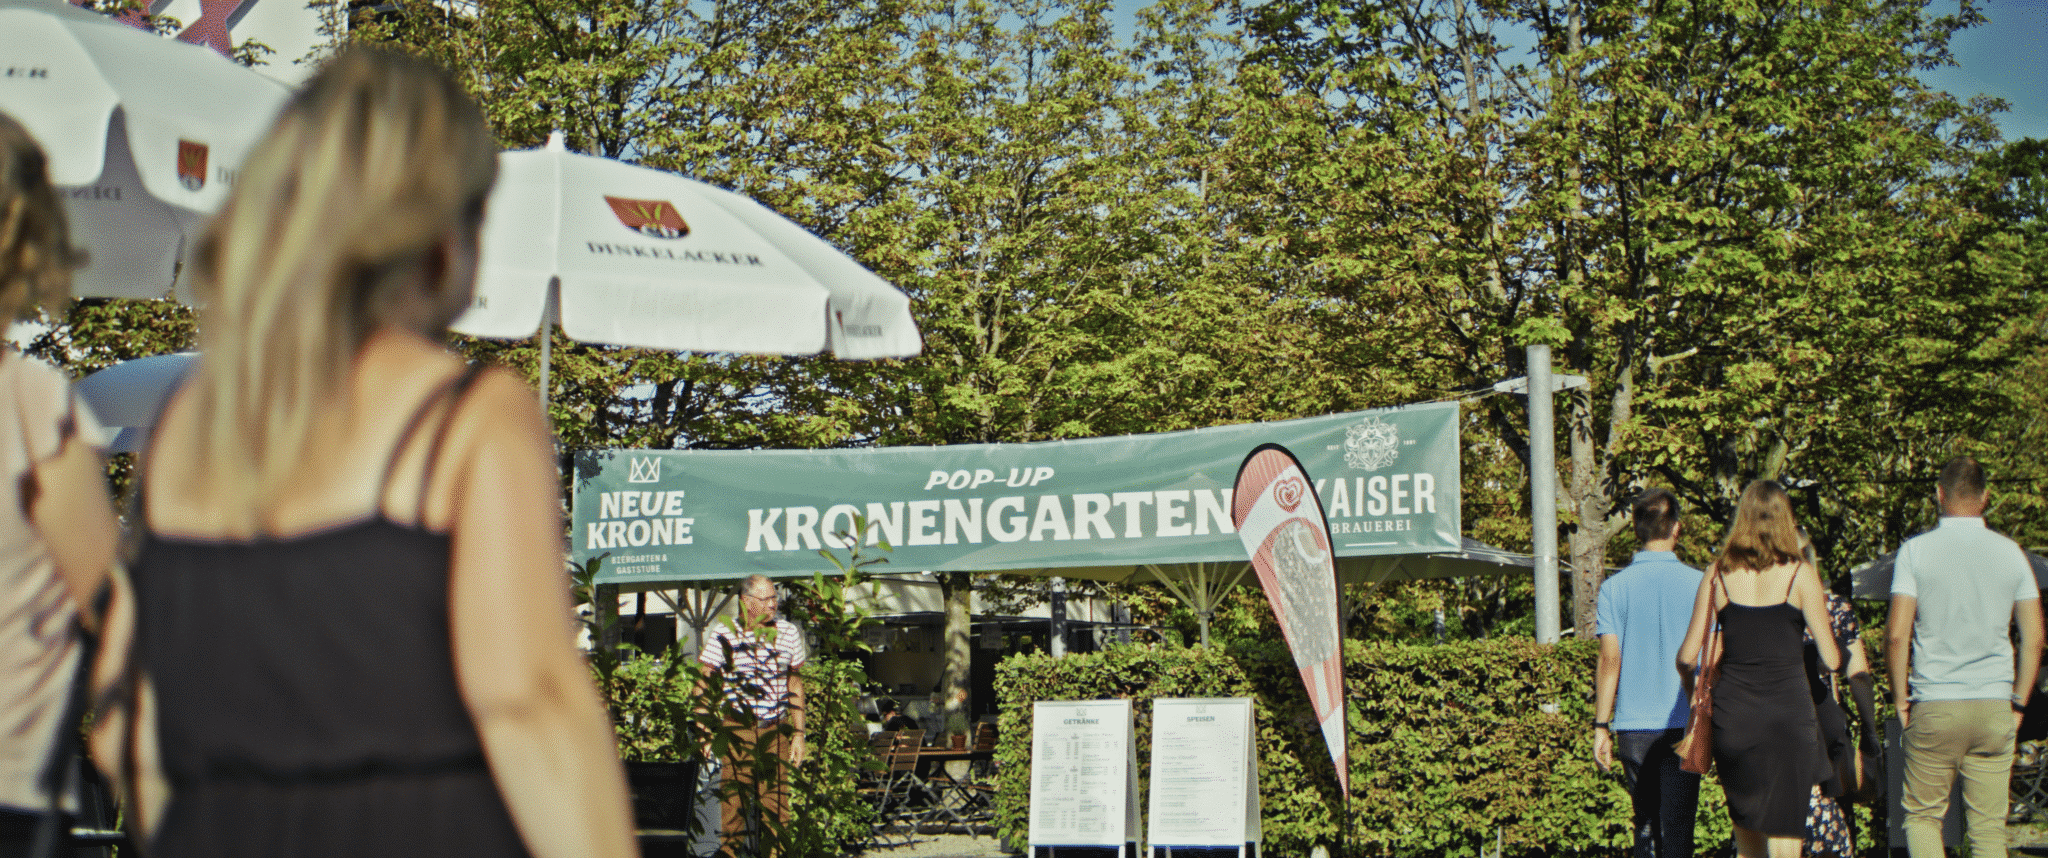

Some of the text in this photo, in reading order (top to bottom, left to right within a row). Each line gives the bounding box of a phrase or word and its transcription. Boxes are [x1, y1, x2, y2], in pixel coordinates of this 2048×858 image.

[586, 241, 764, 267] DINKELACKER
[924, 467, 1055, 490] POP-UP
[600, 490, 685, 519] NEUE
[1314, 473, 1436, 518] AISER
[745, 488, 1236, 552] KRONENGARTEN
[1332, 519, 1412, 534] BRAUEREI
[587, 518, 695, 549] KRONE
[611, 553, 668, 564] BIERGARTEN &
[616, 564, 661, 575] GASTSTUBE
[1063, 717, 1100, 725] GETRÄNKE
